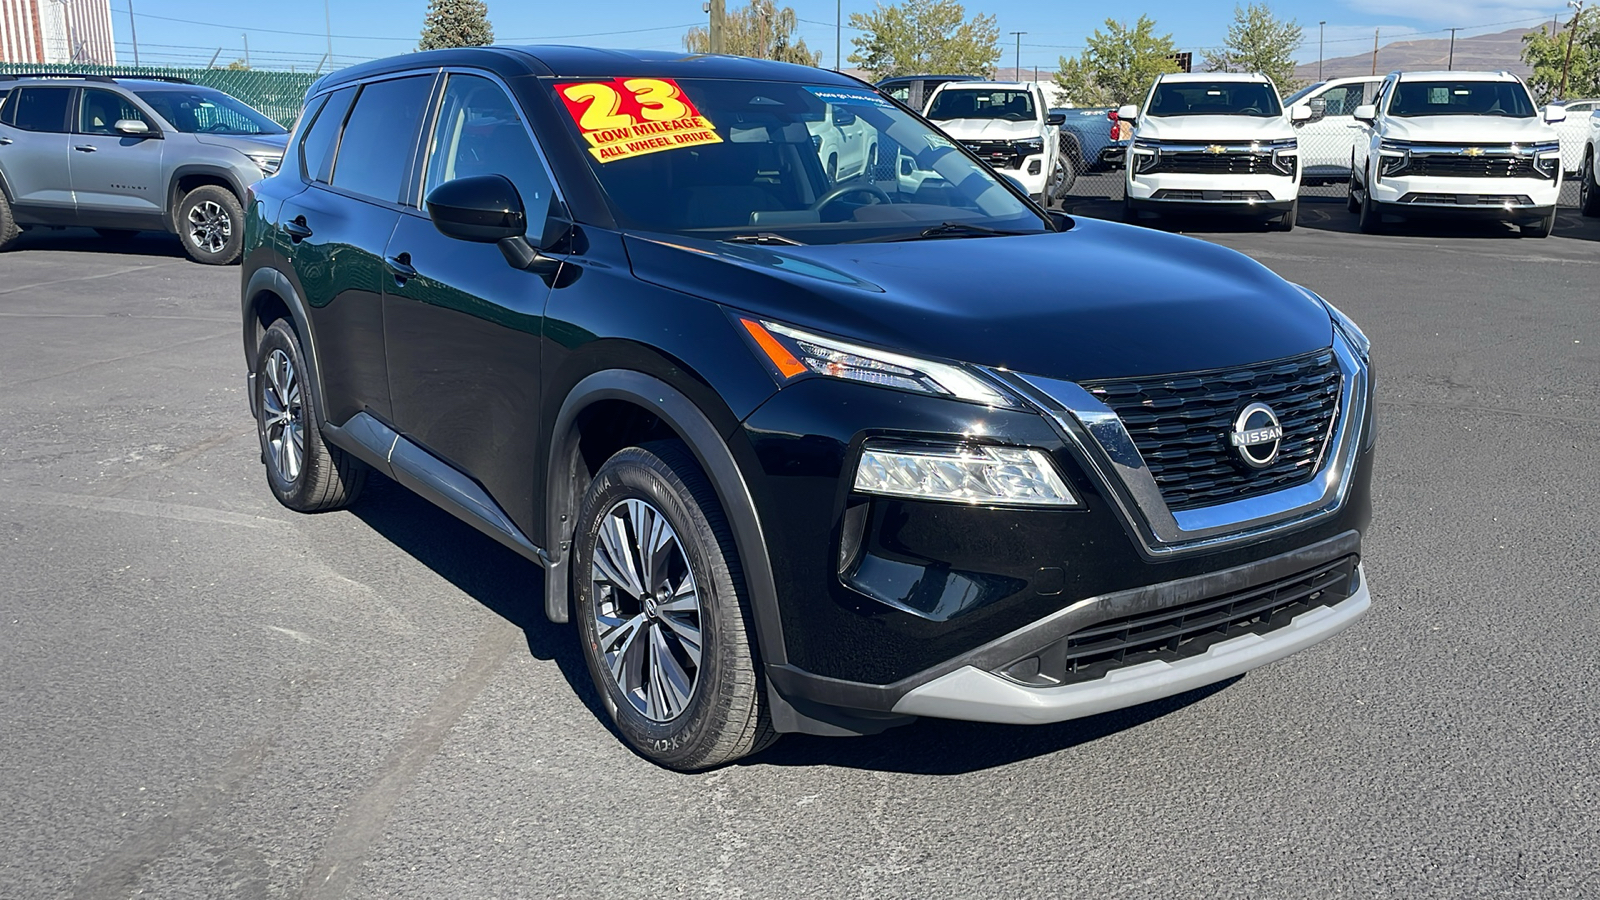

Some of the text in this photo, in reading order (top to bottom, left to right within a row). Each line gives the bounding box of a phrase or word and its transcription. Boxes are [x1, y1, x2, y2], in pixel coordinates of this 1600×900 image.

[563, 78, 692, 130] 23
[592, 117, 704, 144] LOW MILEAGE
[600, 131, 714, 159] ALL WHEEL DRIVE
[1233, 425, 1283, 445] NISSAN
